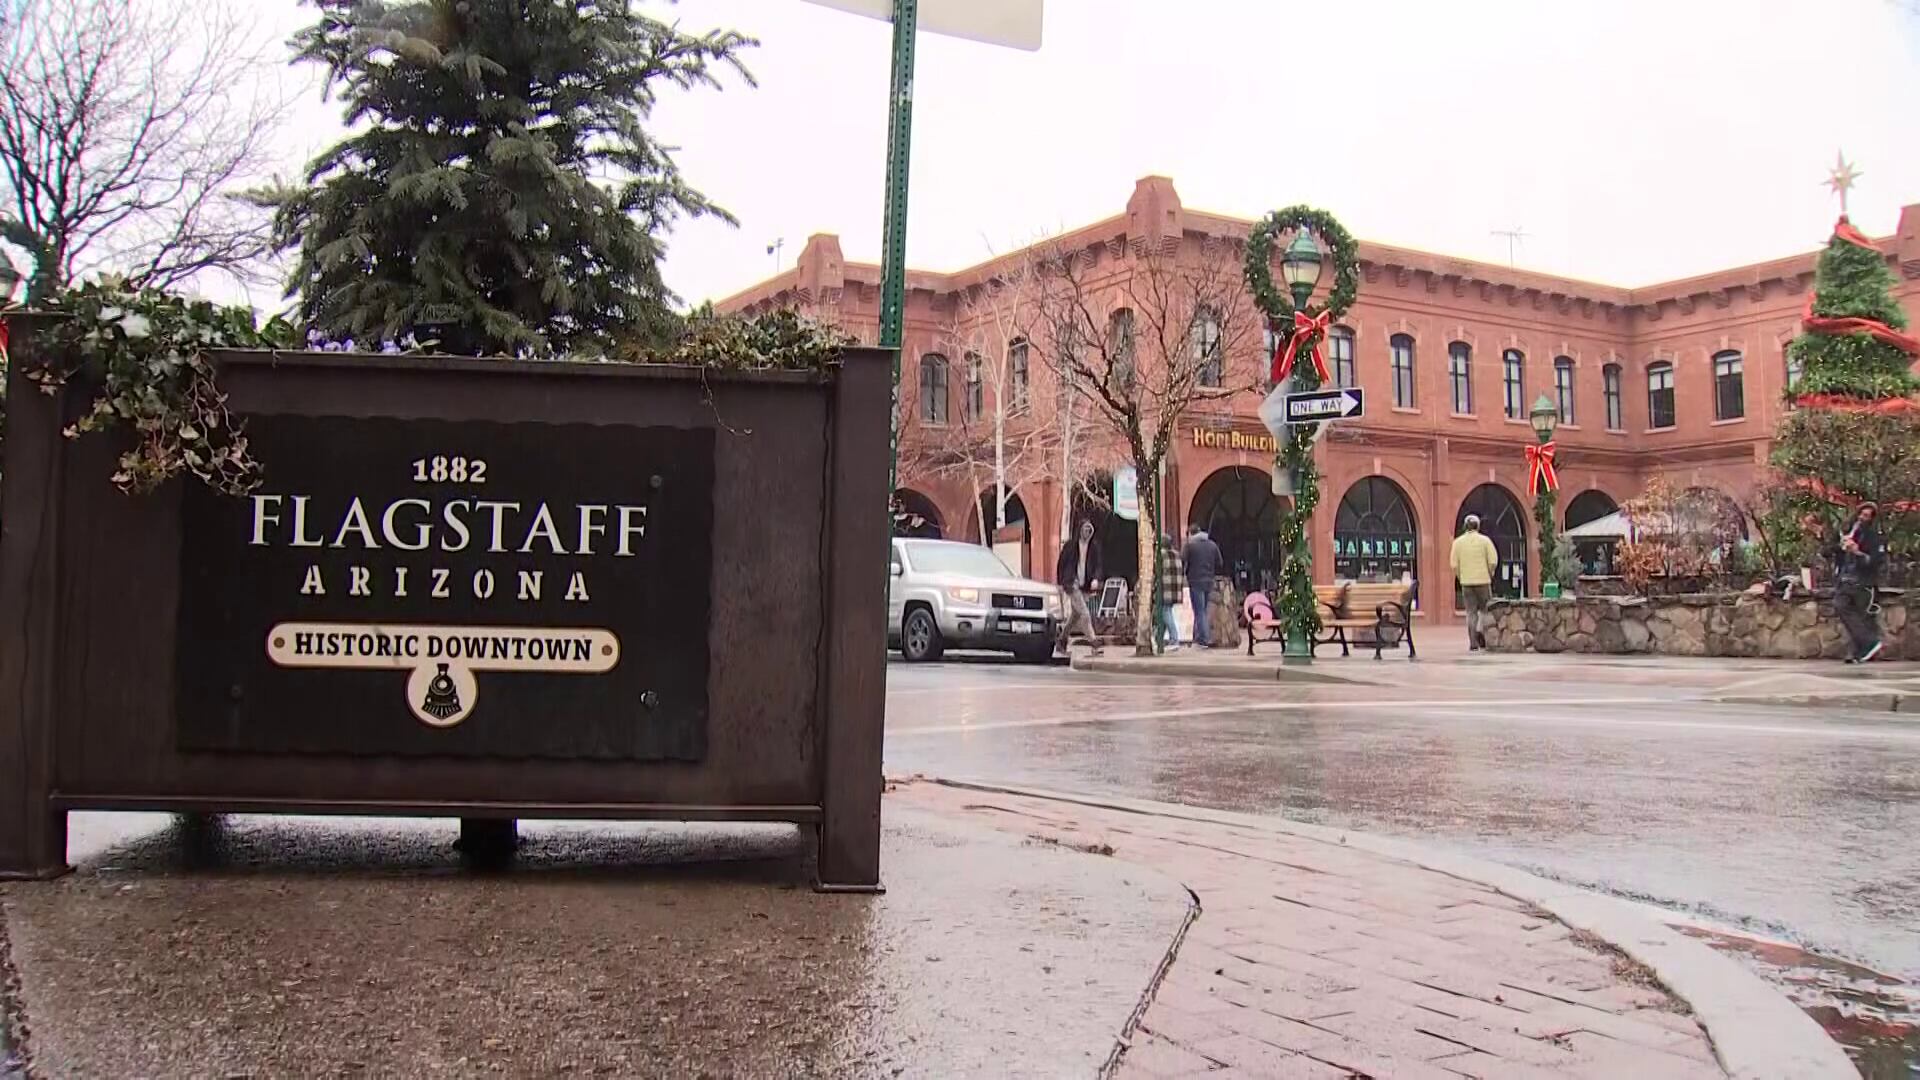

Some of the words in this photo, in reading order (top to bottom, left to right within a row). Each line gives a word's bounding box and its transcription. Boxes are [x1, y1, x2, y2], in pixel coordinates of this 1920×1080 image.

[1292, 403, 1314, 415] ONE
[1321, 400, 1343, 412] WAY
[412, 456, 488, 483] 1882
[247, 494, 648, 557] FLAGSTAFF
[1334, 539, 1412, 554] BAKERY
[300, 564, 590, 601] ARIZONA
[294, 632, 419, 658] HISTORIC
[426, 635, 593, 662] DOWNTOWN
